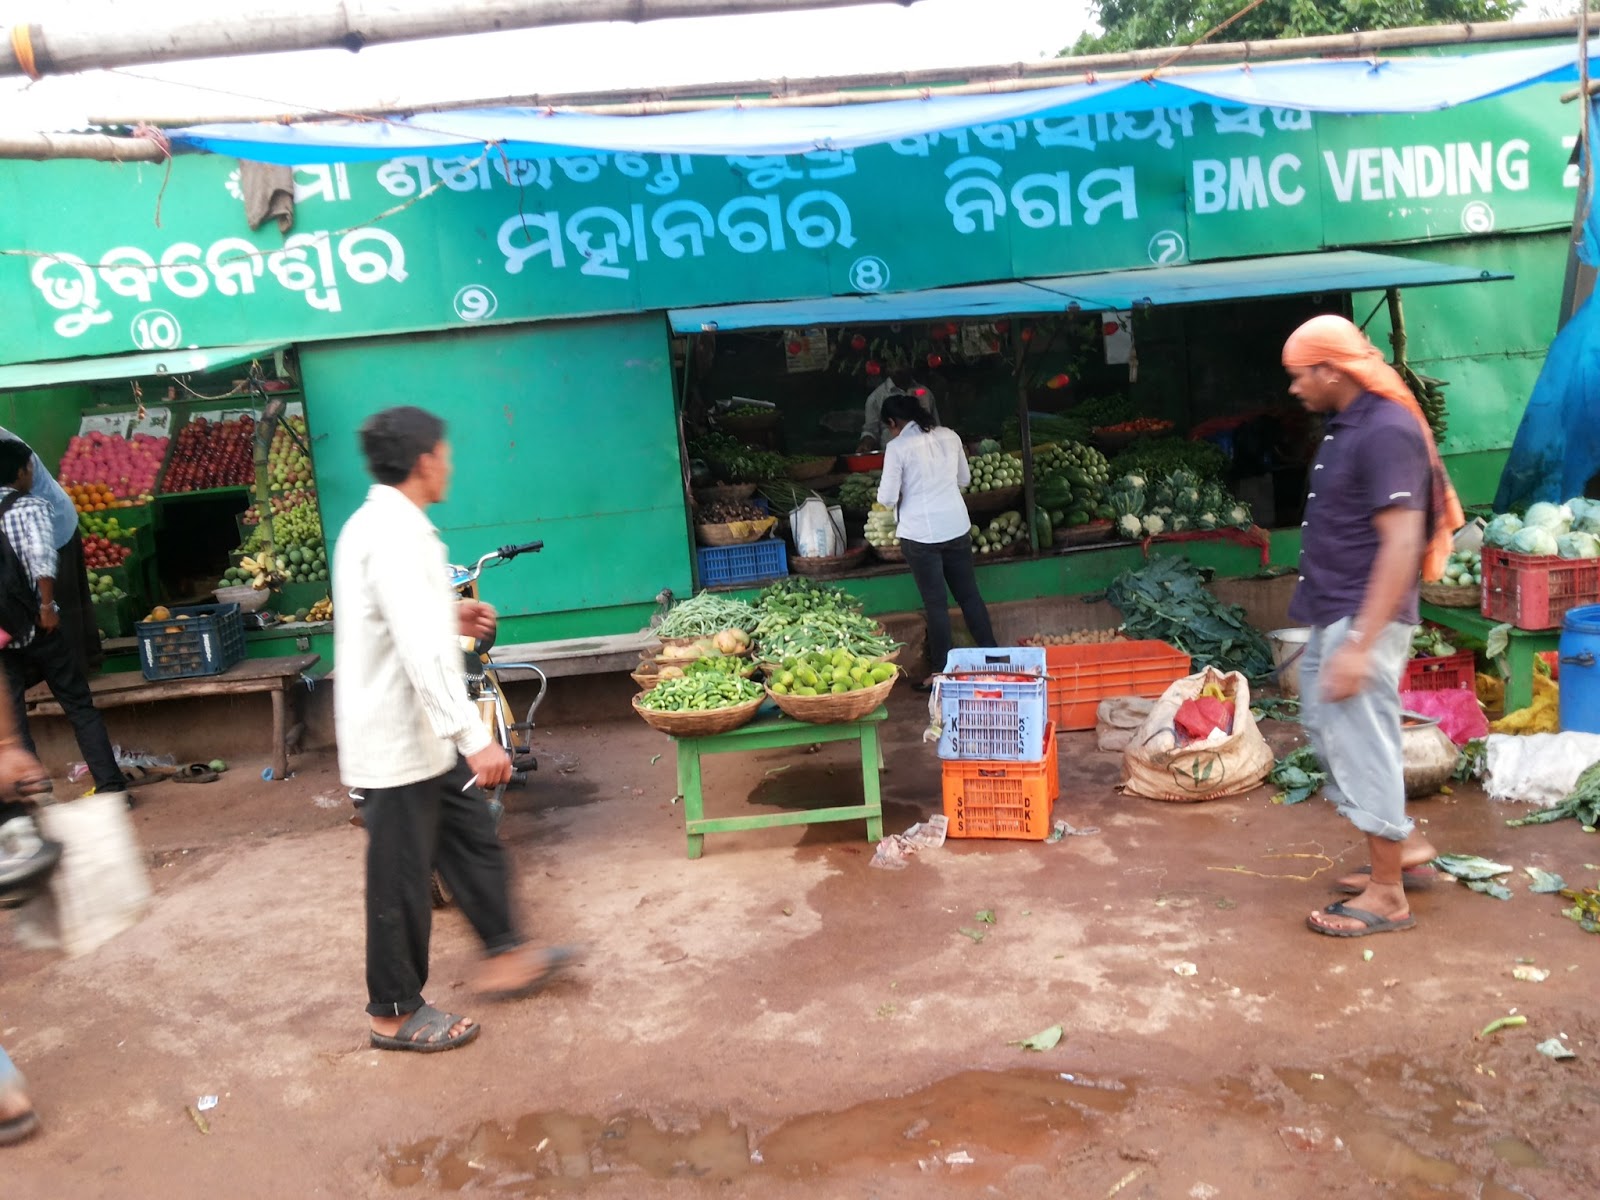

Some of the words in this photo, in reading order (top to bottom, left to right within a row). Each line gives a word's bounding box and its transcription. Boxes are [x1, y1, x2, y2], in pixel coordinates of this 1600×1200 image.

[1192, 153, 1306, 214] BMC
[1323, 139, 1530, 202] VENDING
[497, 190, 857, 280] ମହାନଗର
[945, 156, 1138, 234] ନିଗମ
[137, 316, 176, 349] 10
